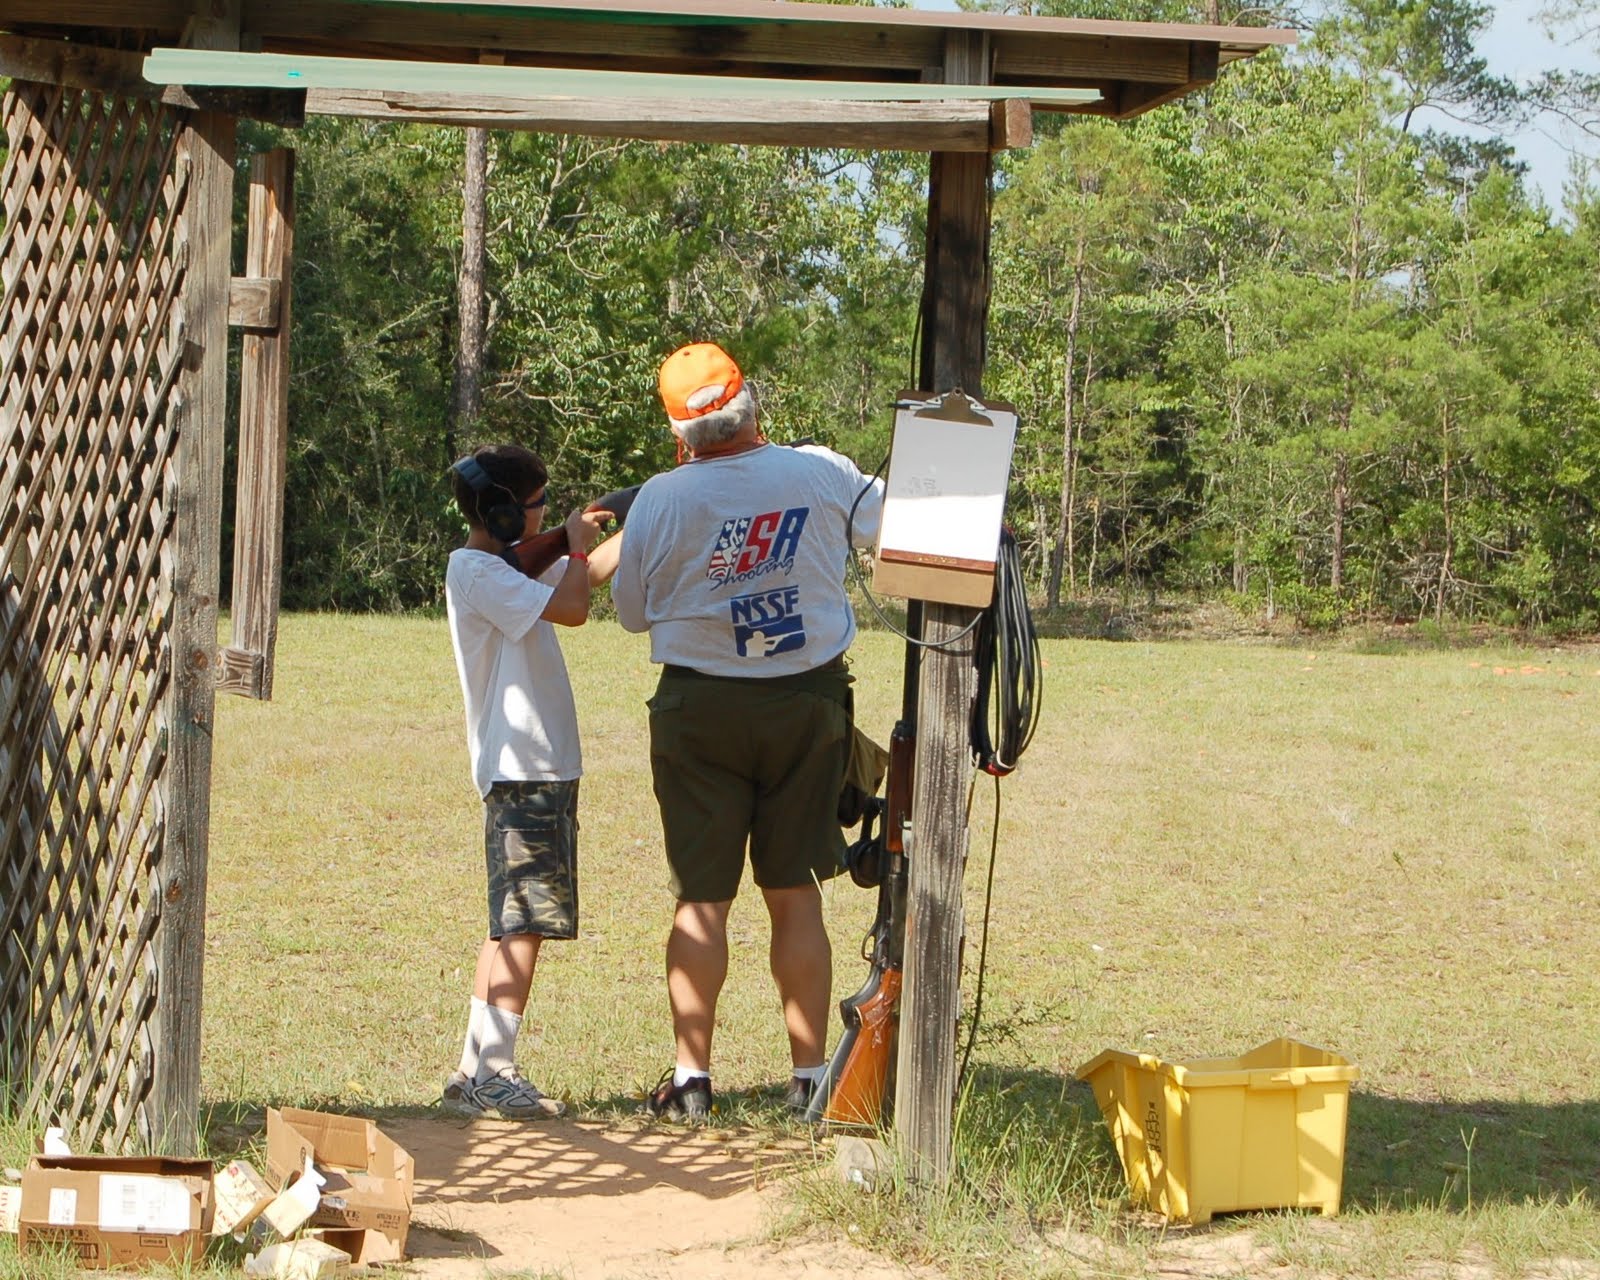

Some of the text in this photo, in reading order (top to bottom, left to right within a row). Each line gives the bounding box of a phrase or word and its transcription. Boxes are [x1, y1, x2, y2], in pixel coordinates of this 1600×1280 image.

[706, 507, 810, 577] USA
[710, 557, 794, 591] Shooting
[730, 589, 799, 627] NSSF
